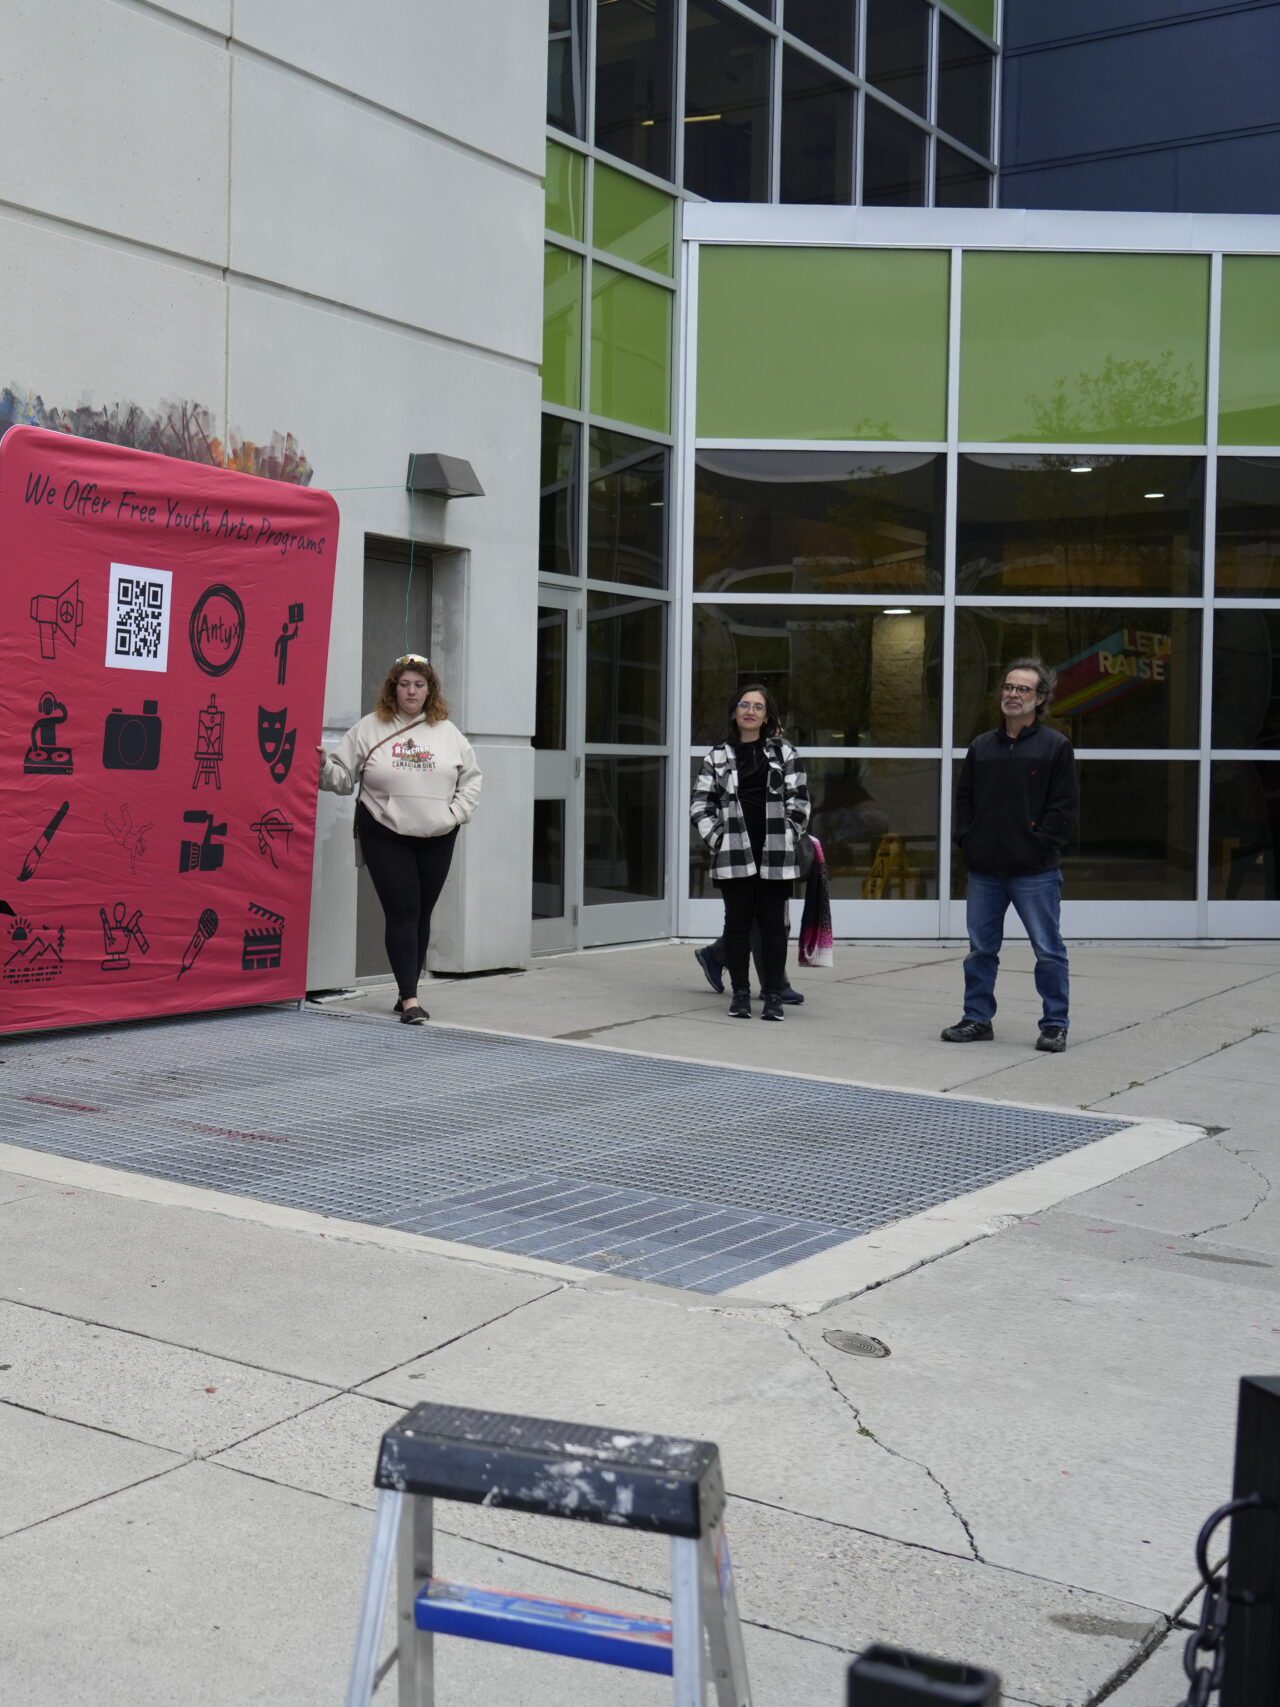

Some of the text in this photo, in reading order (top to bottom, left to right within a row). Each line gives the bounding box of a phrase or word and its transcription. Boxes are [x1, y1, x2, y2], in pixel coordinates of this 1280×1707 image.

[24, 471, 326, 555] We Offer Free Youth Arts Programs
[197, 614, 242, 650] Antyx
[1099, 651, 1165, 681] RAISE
